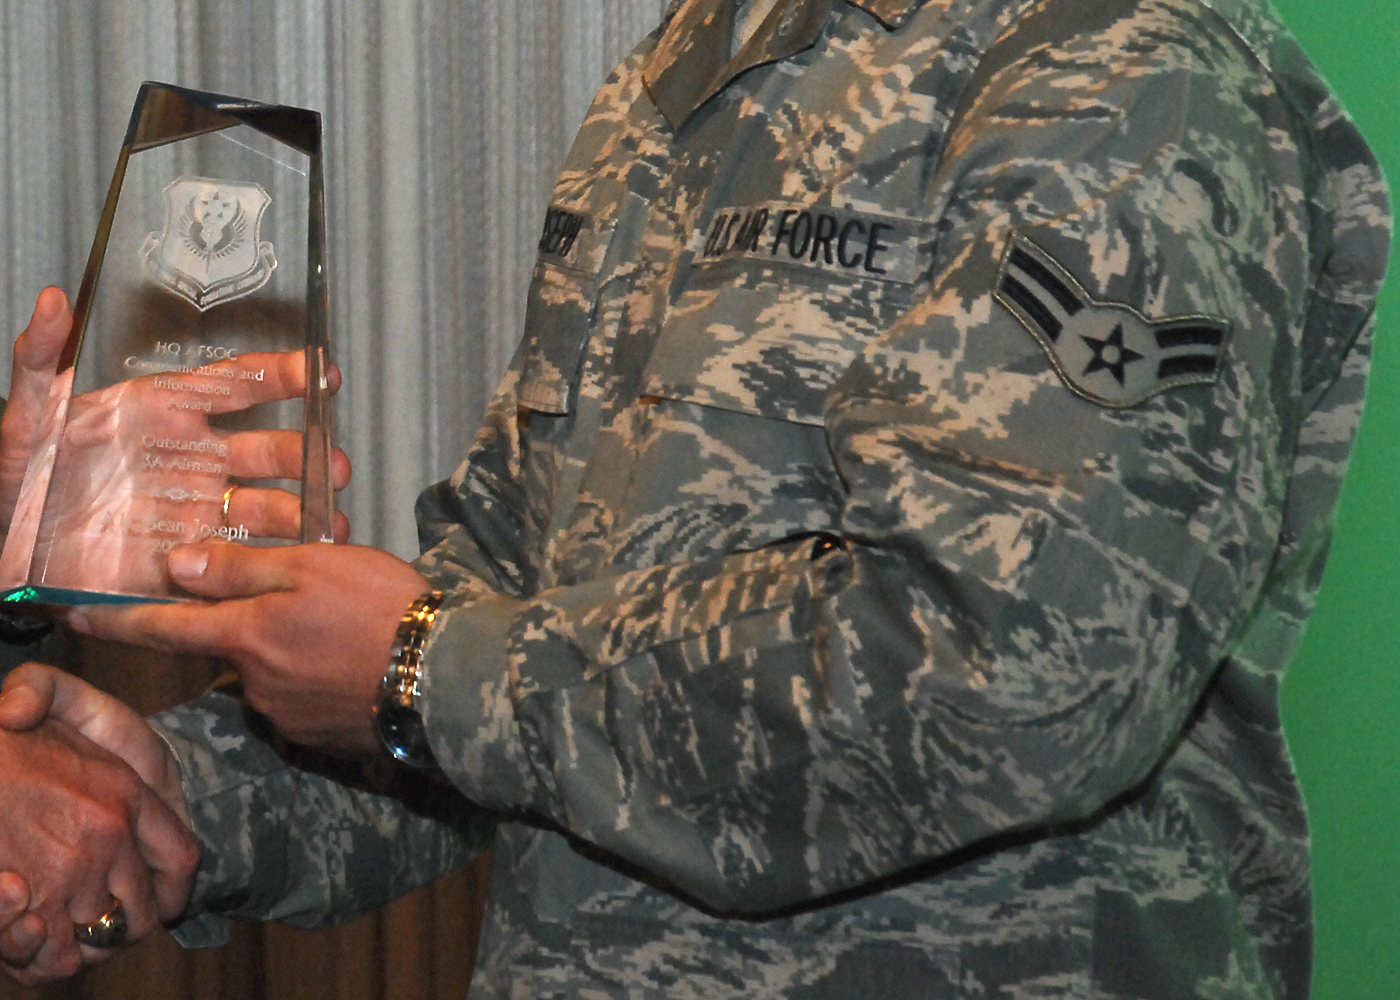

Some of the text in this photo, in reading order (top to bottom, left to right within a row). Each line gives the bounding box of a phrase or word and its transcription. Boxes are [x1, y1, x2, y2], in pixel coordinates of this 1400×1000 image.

[771, 209, 895, 275] FORCE
[155, 340, 180, 356] HQ
[240, 367, 265, 382] and
[154, 376, 231, 396] Information
[141, 434, 228, 458] Outstanding
[169, 457, 222, 474] Airman
[188, 518, 249, 541] Joseph
